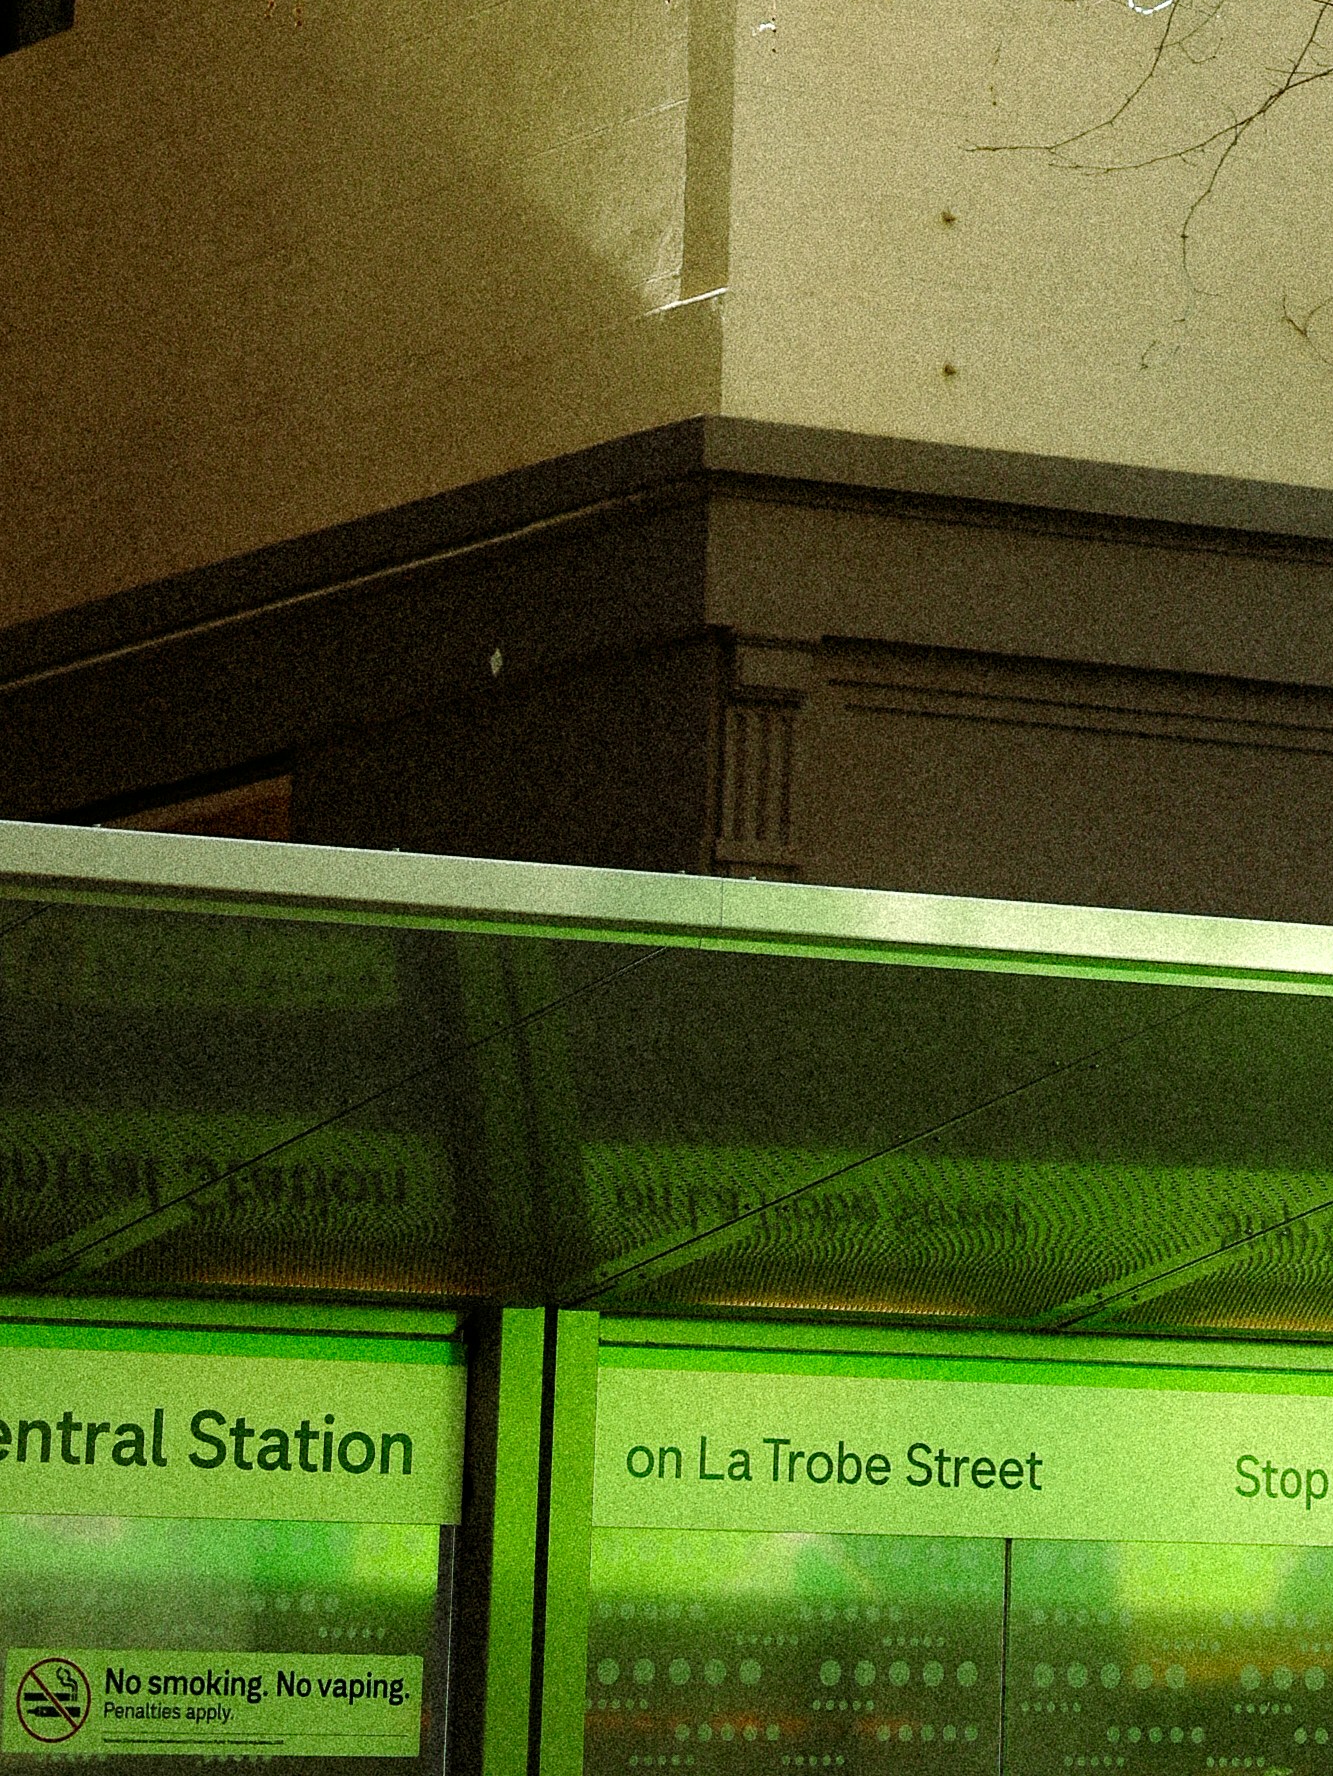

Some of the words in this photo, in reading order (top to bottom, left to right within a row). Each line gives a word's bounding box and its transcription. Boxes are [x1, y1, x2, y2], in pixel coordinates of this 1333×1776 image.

[188, 1409, 413, 1475] Station
[626, 1444, 682, 1479] on
[700, 1436, 752, 1482] La
[763, 1437, 891, 1486] Trobe
[906, 1442, 1043, 1491] Street
[1235, 1454, 1329, 1511] Stop
[103, 1701, 181, 1720] Penalties
[185, 1702, 234, 1724] apply.
[105, 1667, 141, 1695] No
[149, 1669, 268, 1704] smoking.
[276, 1670, 312, 1698] No
[318, 1671, 410, 1706] vaping.
